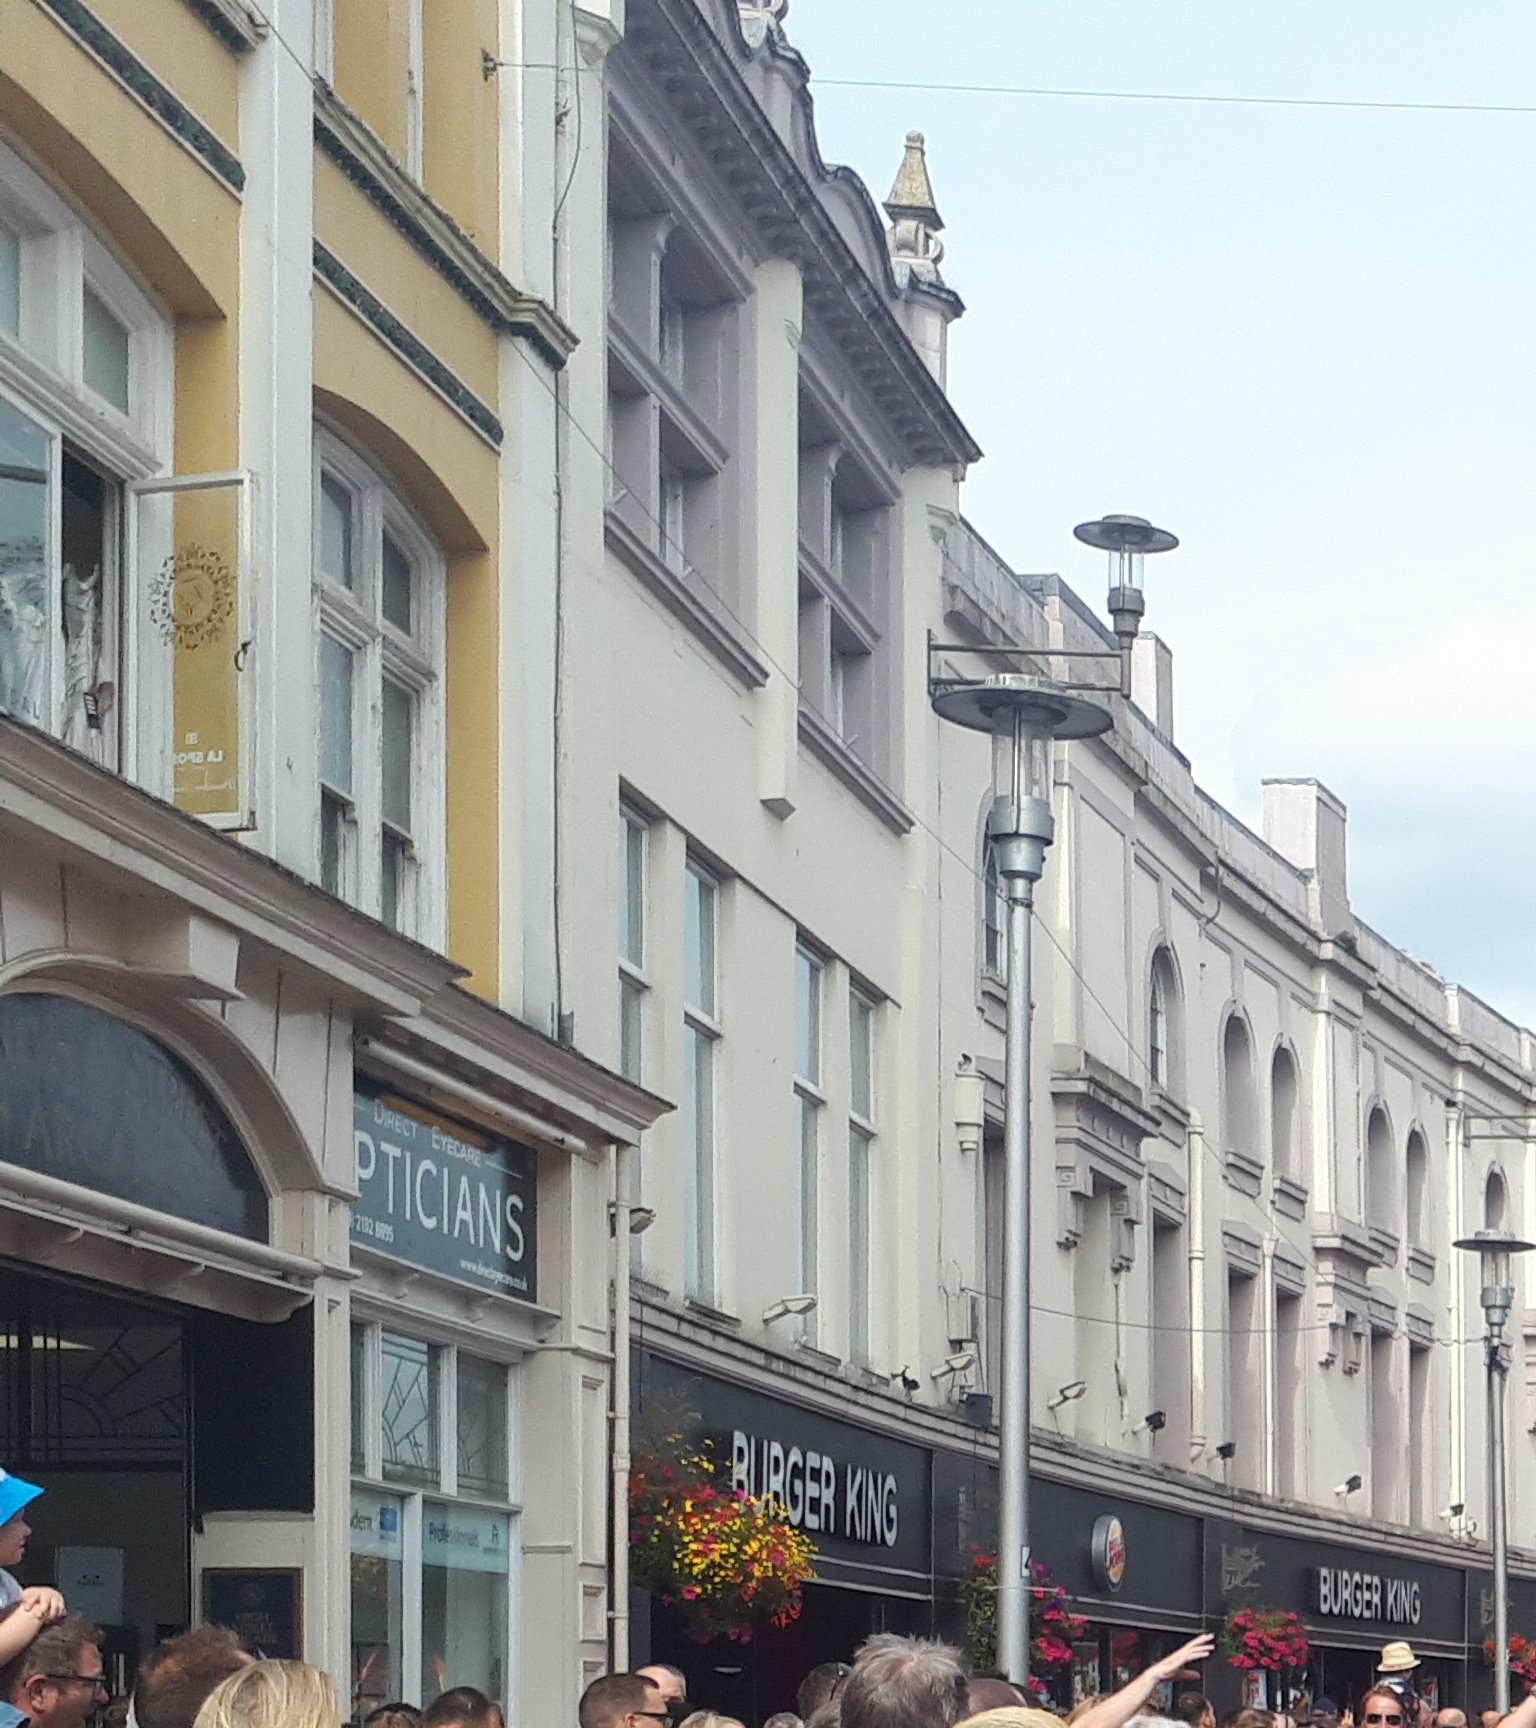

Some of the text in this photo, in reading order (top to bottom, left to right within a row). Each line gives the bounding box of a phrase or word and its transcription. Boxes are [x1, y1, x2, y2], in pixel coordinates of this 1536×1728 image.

[354, 1131, 525, 1262] PTICIANS
[732, 1430, 898, 1547] BURGER KING
[1320, 1567, 1421, 1625] BURGER KING
